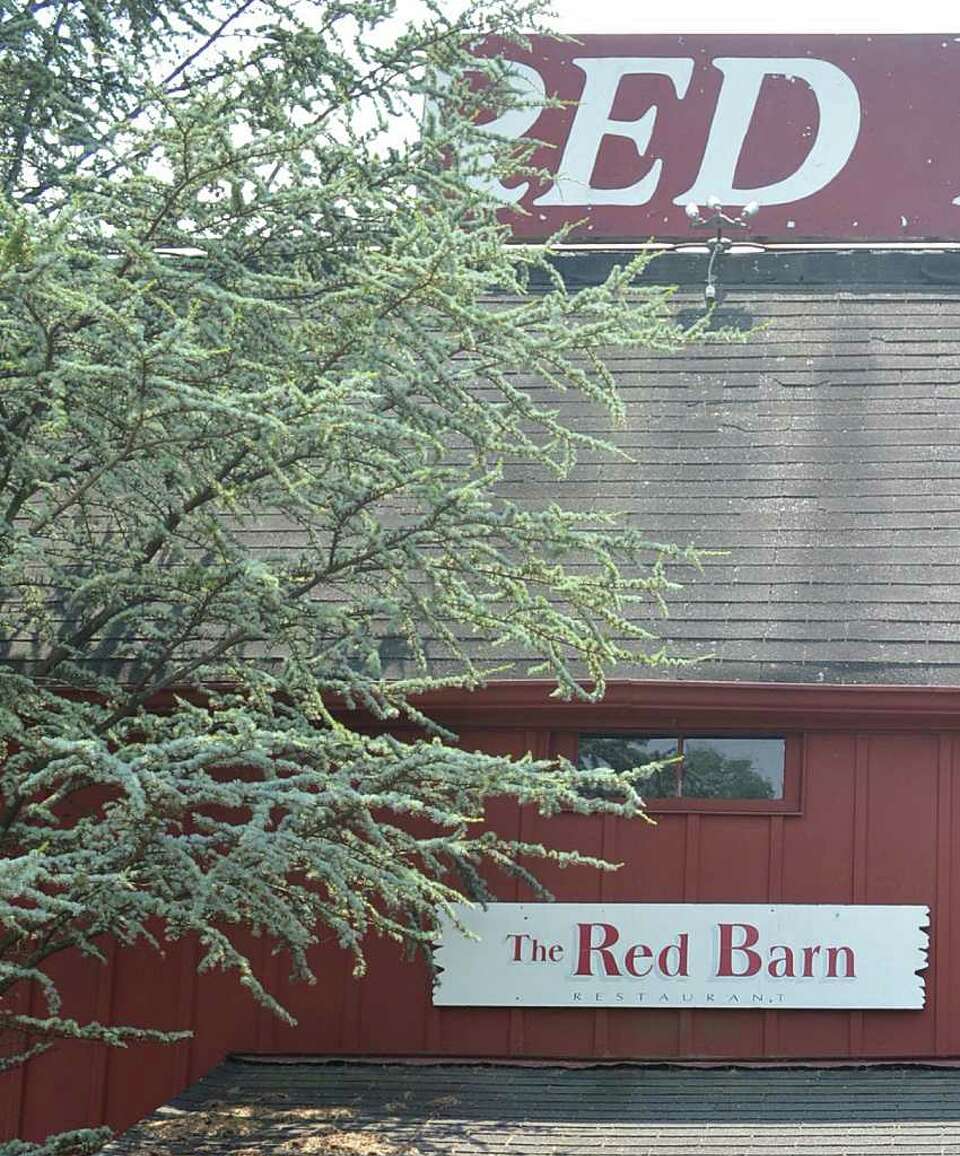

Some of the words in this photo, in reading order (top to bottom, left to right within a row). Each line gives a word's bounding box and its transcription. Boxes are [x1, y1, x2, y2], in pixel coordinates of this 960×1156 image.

[505, 933, 564, 964] The
[571, 922, 690, 979] Red
[714, 922, 857, 979] Barn
[572, 992, 786, 1002] RESTAURANT
